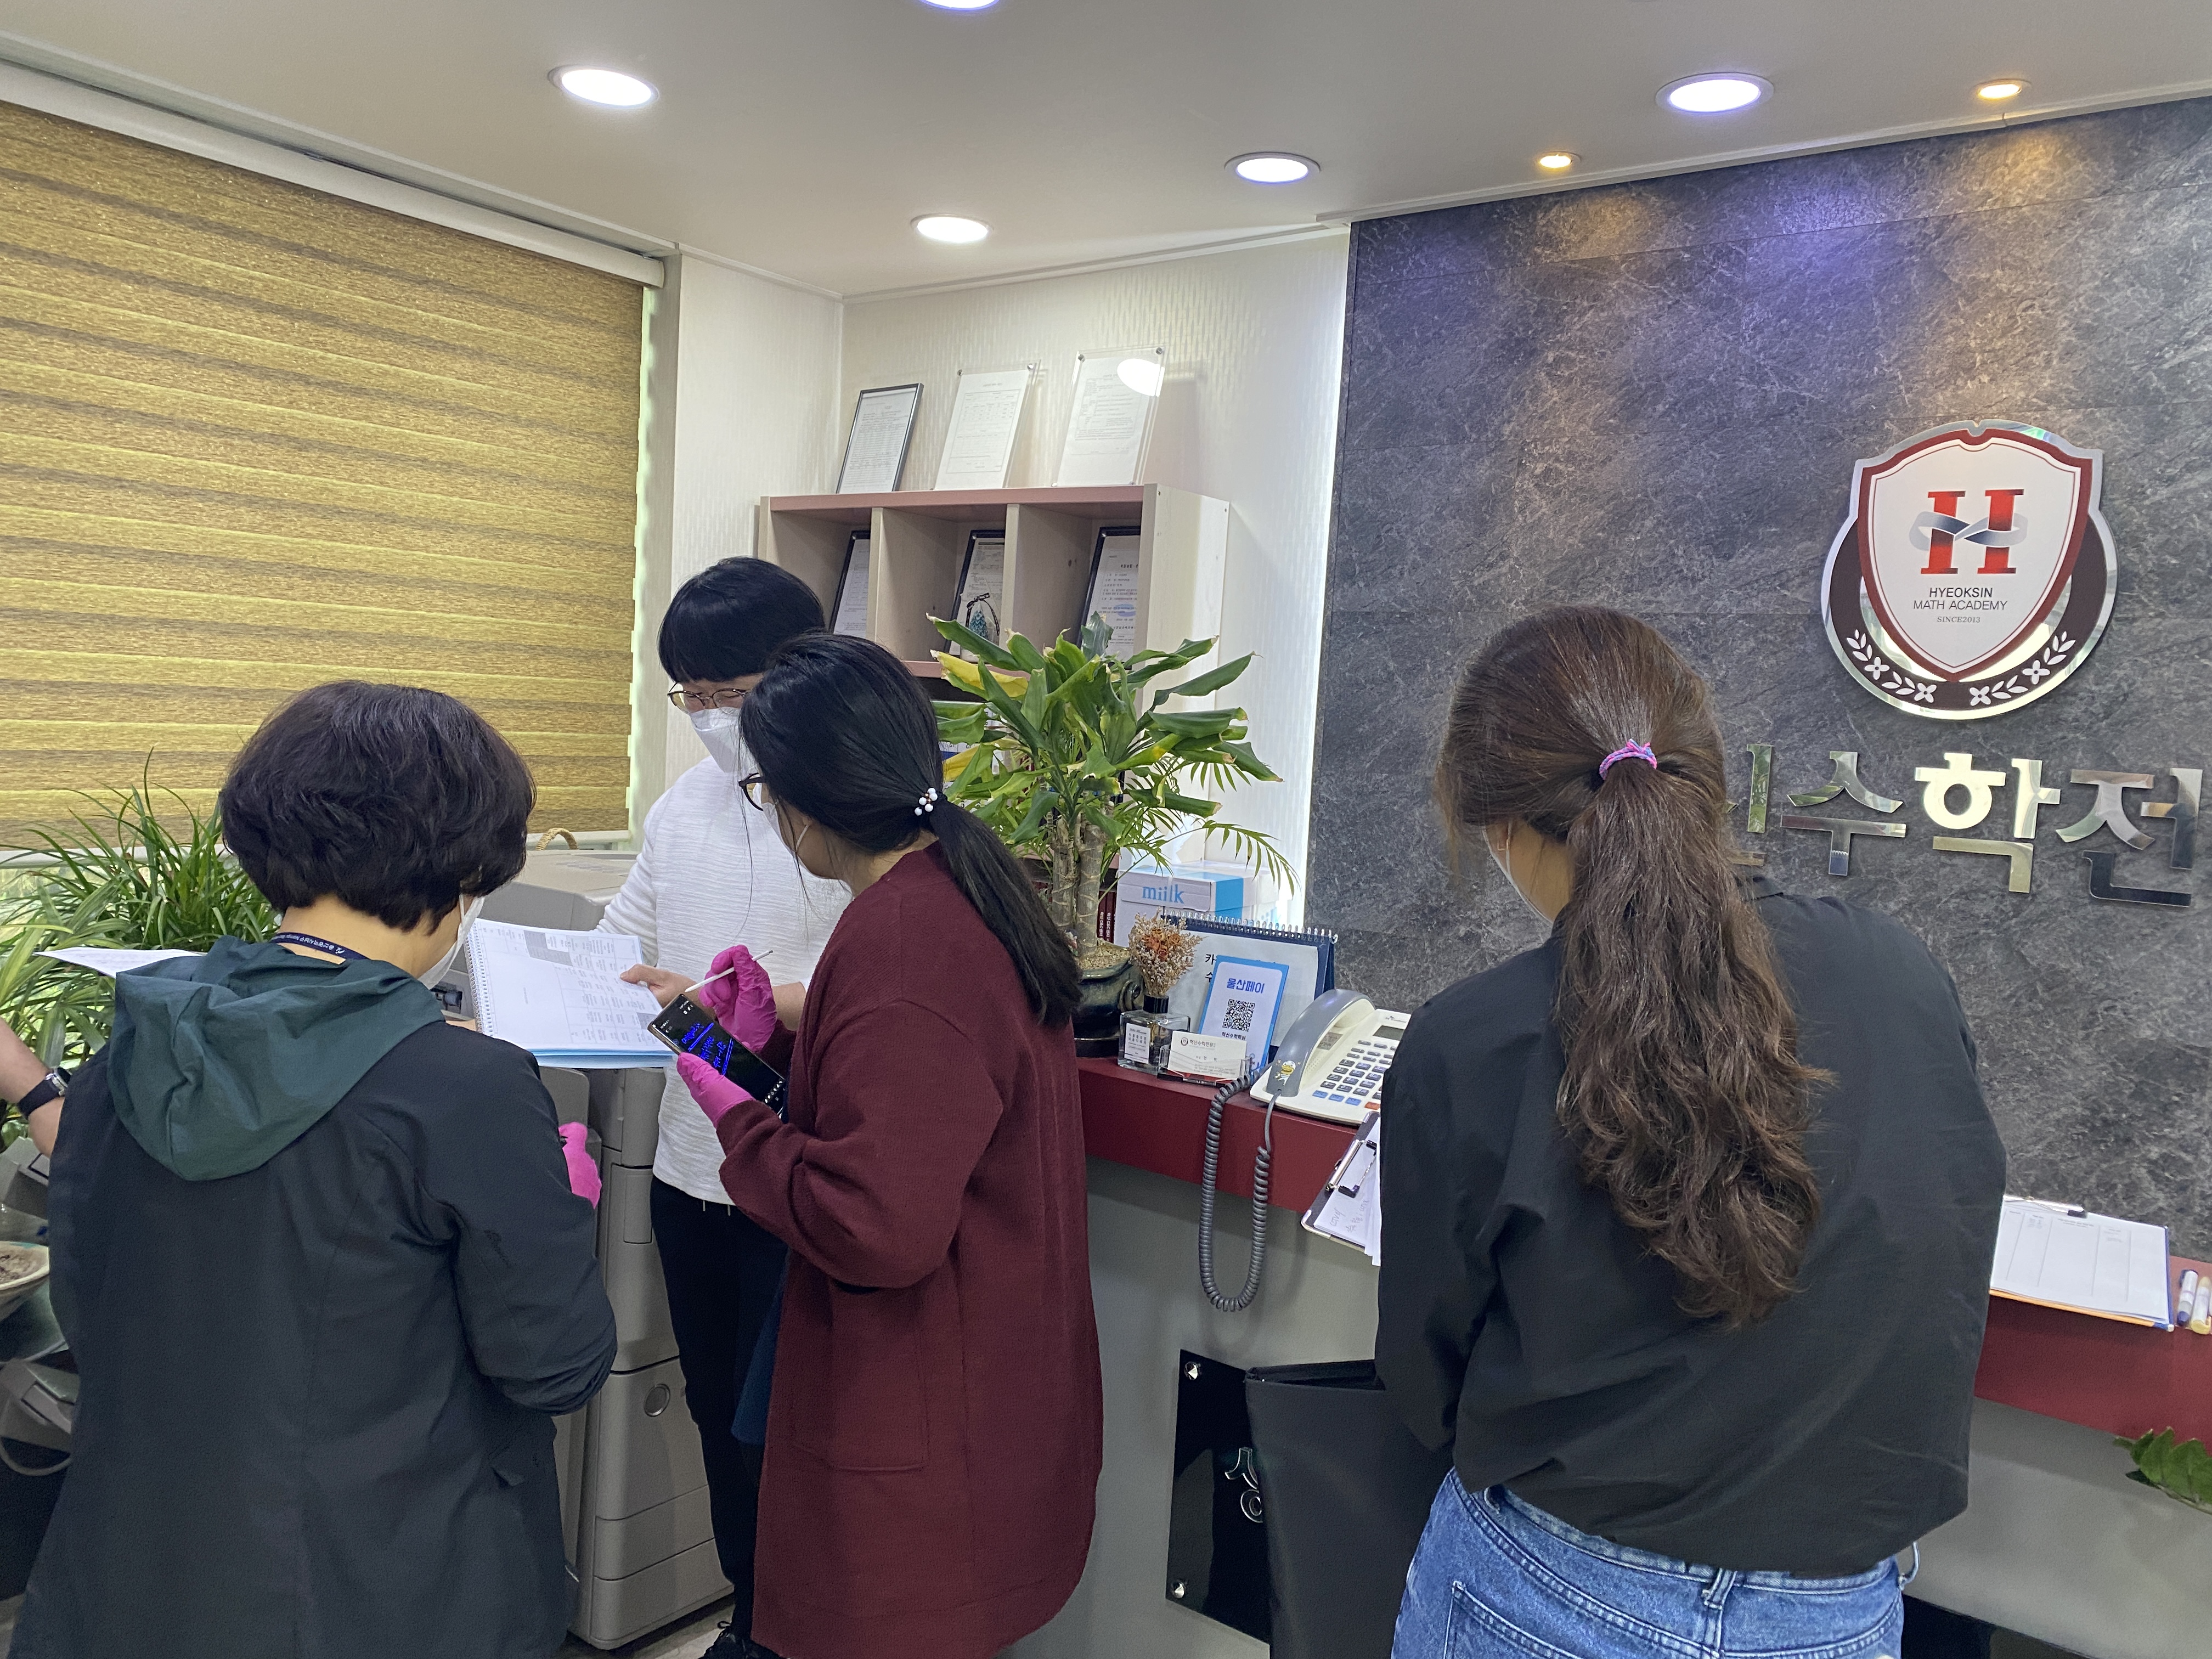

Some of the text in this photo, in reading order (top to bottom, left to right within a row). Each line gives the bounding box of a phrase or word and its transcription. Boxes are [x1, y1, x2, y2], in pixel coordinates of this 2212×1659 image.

[1928, 586, 1994, 598] HYEOKSIN
[1912, 600, 2008, 611] MATH ACADEMY
[1936, 615, 1981, 623] SINCE2013
[1205, 954, 1216, 965] 카
[1227, 978, 1265, 994] 울산페이
[1222, 1031, 1246, 1041] 혁신수학학원
